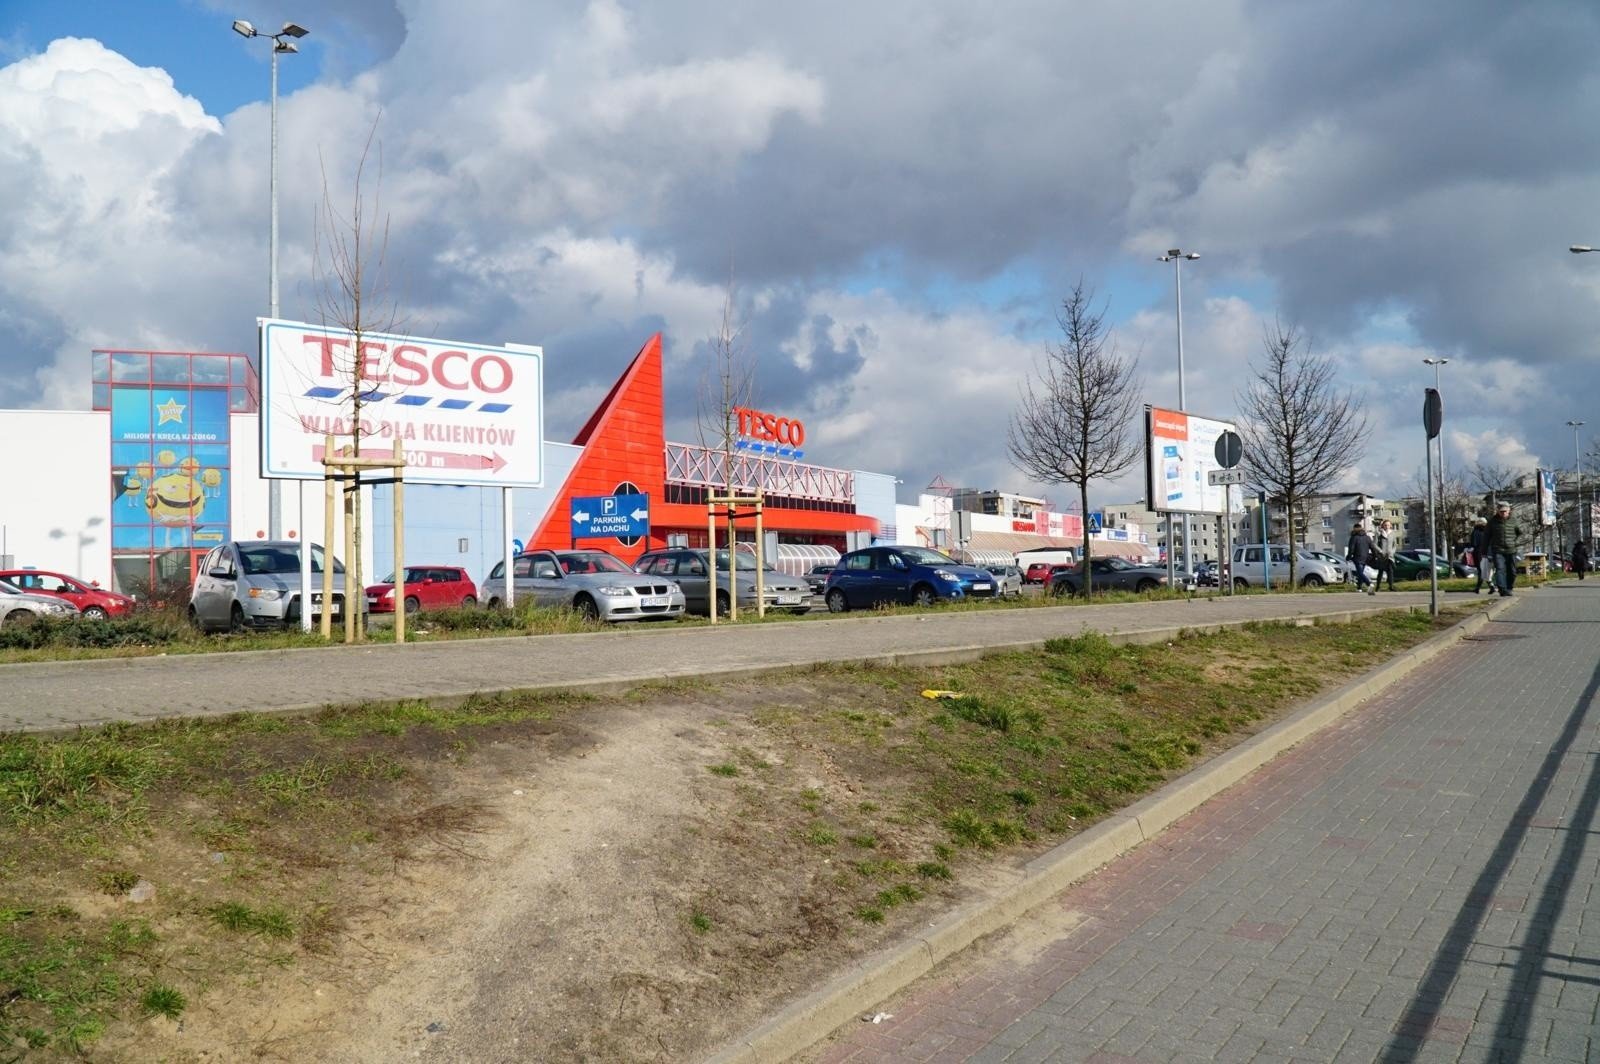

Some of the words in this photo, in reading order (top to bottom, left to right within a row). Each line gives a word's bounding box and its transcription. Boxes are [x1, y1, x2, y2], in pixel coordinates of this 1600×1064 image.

[303, 335, 513, 393] TESCO
[302, 414, 372, 436] WJAZD
[381, 420, 416, 441] DLA
[424, 423, 516, 446] KLIENTÓW
[734, 406, 804, 446] TESCO
[431, 455, 445, 467] m
[604, 499, 614, 514] P
[593, 515, 627, 525] PARKING
[602, 524, 630, 533] DACHU
